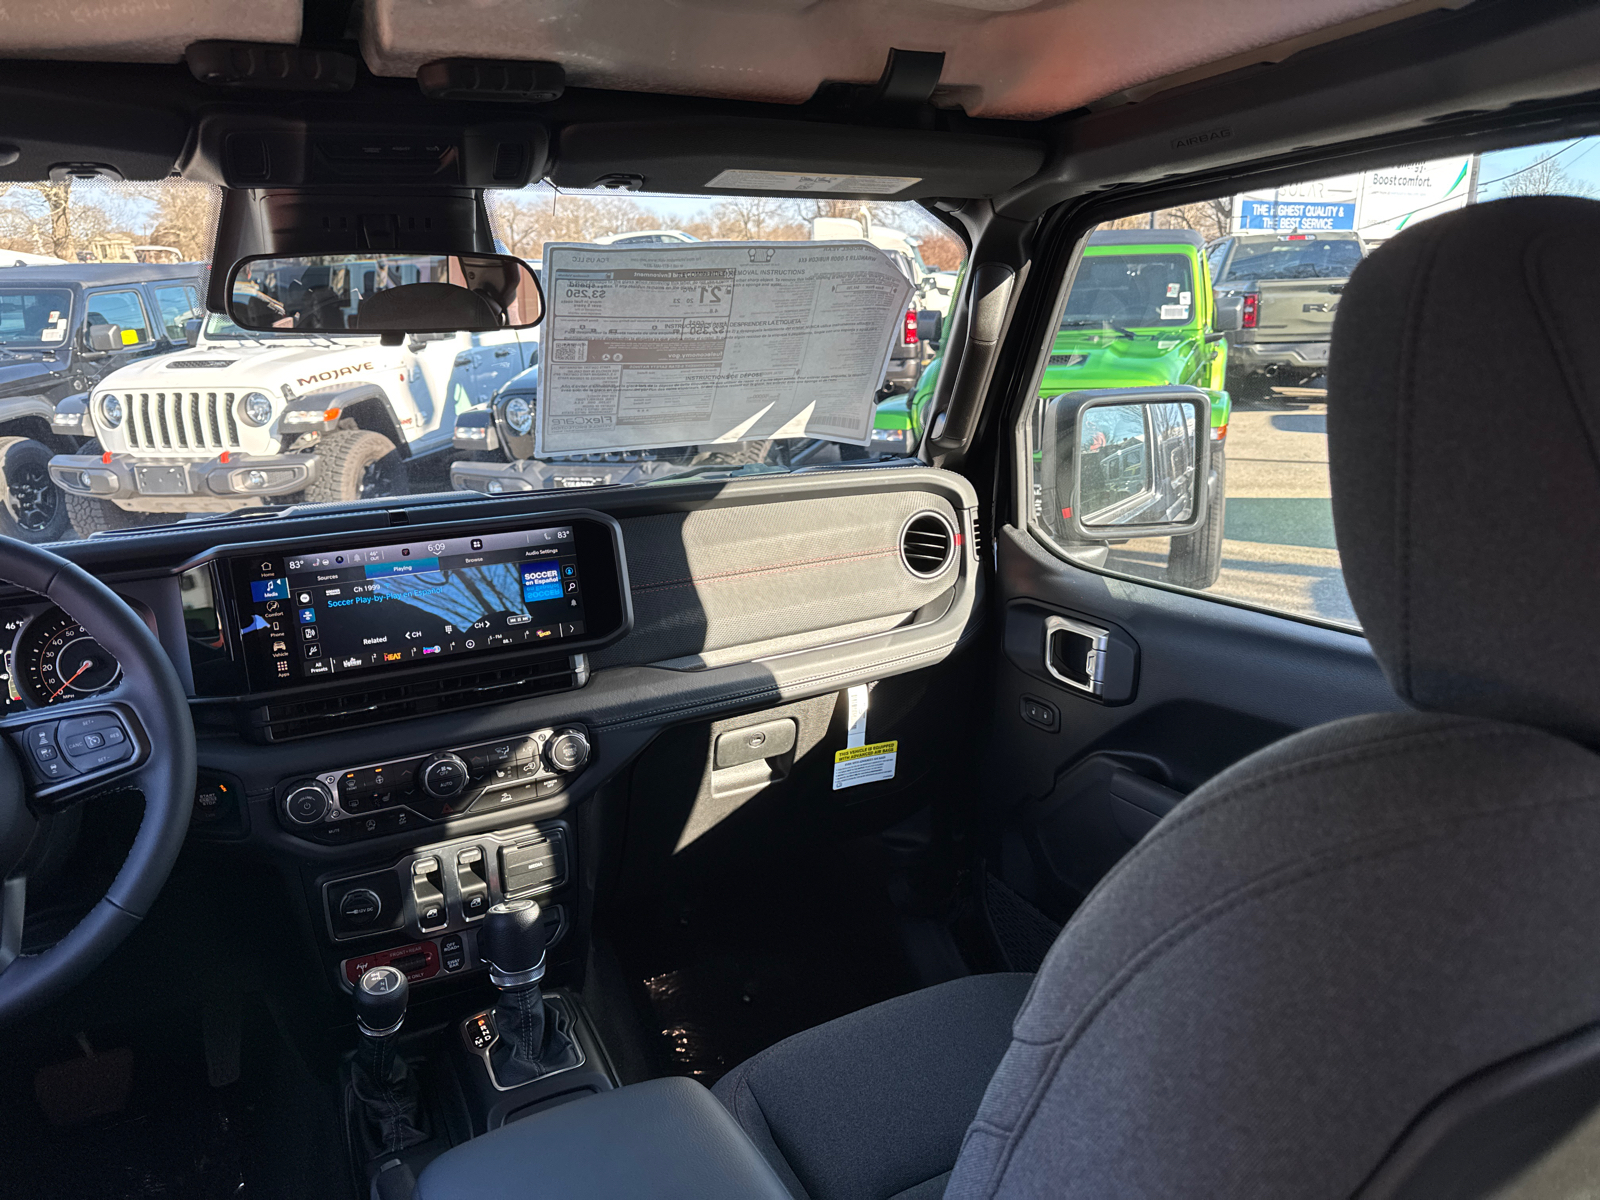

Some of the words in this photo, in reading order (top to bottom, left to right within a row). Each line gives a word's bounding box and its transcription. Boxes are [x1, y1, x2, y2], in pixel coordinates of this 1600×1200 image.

[1176, 129, 1231, 148] AIRBAG
[1372, 173, 1397, 186] Boost
[1398, 175, 1432, 187] comfort.
[1252, 204, 1269, 216] THE
[1270, 205, 1305, 217] HGHEST
[1305, 206, 1337, 217] QUALITY
[1338, 206, 1345, 217] &
[1280, 218, 1301, 229] BEST
[1301, 218, 1333, 229] SERVICE
[296, 361, 374, 386] MOJAVE
[557, 530, 570, 539] 83°
[427, 542, 446, 552] 6:09
[289, 560, 304, 569] 83°
[524, 570, 558, 580] SOCCER
[534, 577, 558, 586] Español
[327, 598, 353, 608] Soccer
[355, 591, 402, 605] Play-by-Play
[414, 587, 443, 598] Español
[363, 636, 387, 645] Related
[384, 652, 402, 661] HEAT
[68, 741, 83, 749] CANC
[850, 747, 867, 755] VEHICLE
[528, 861, 544, 870] MEDIA
